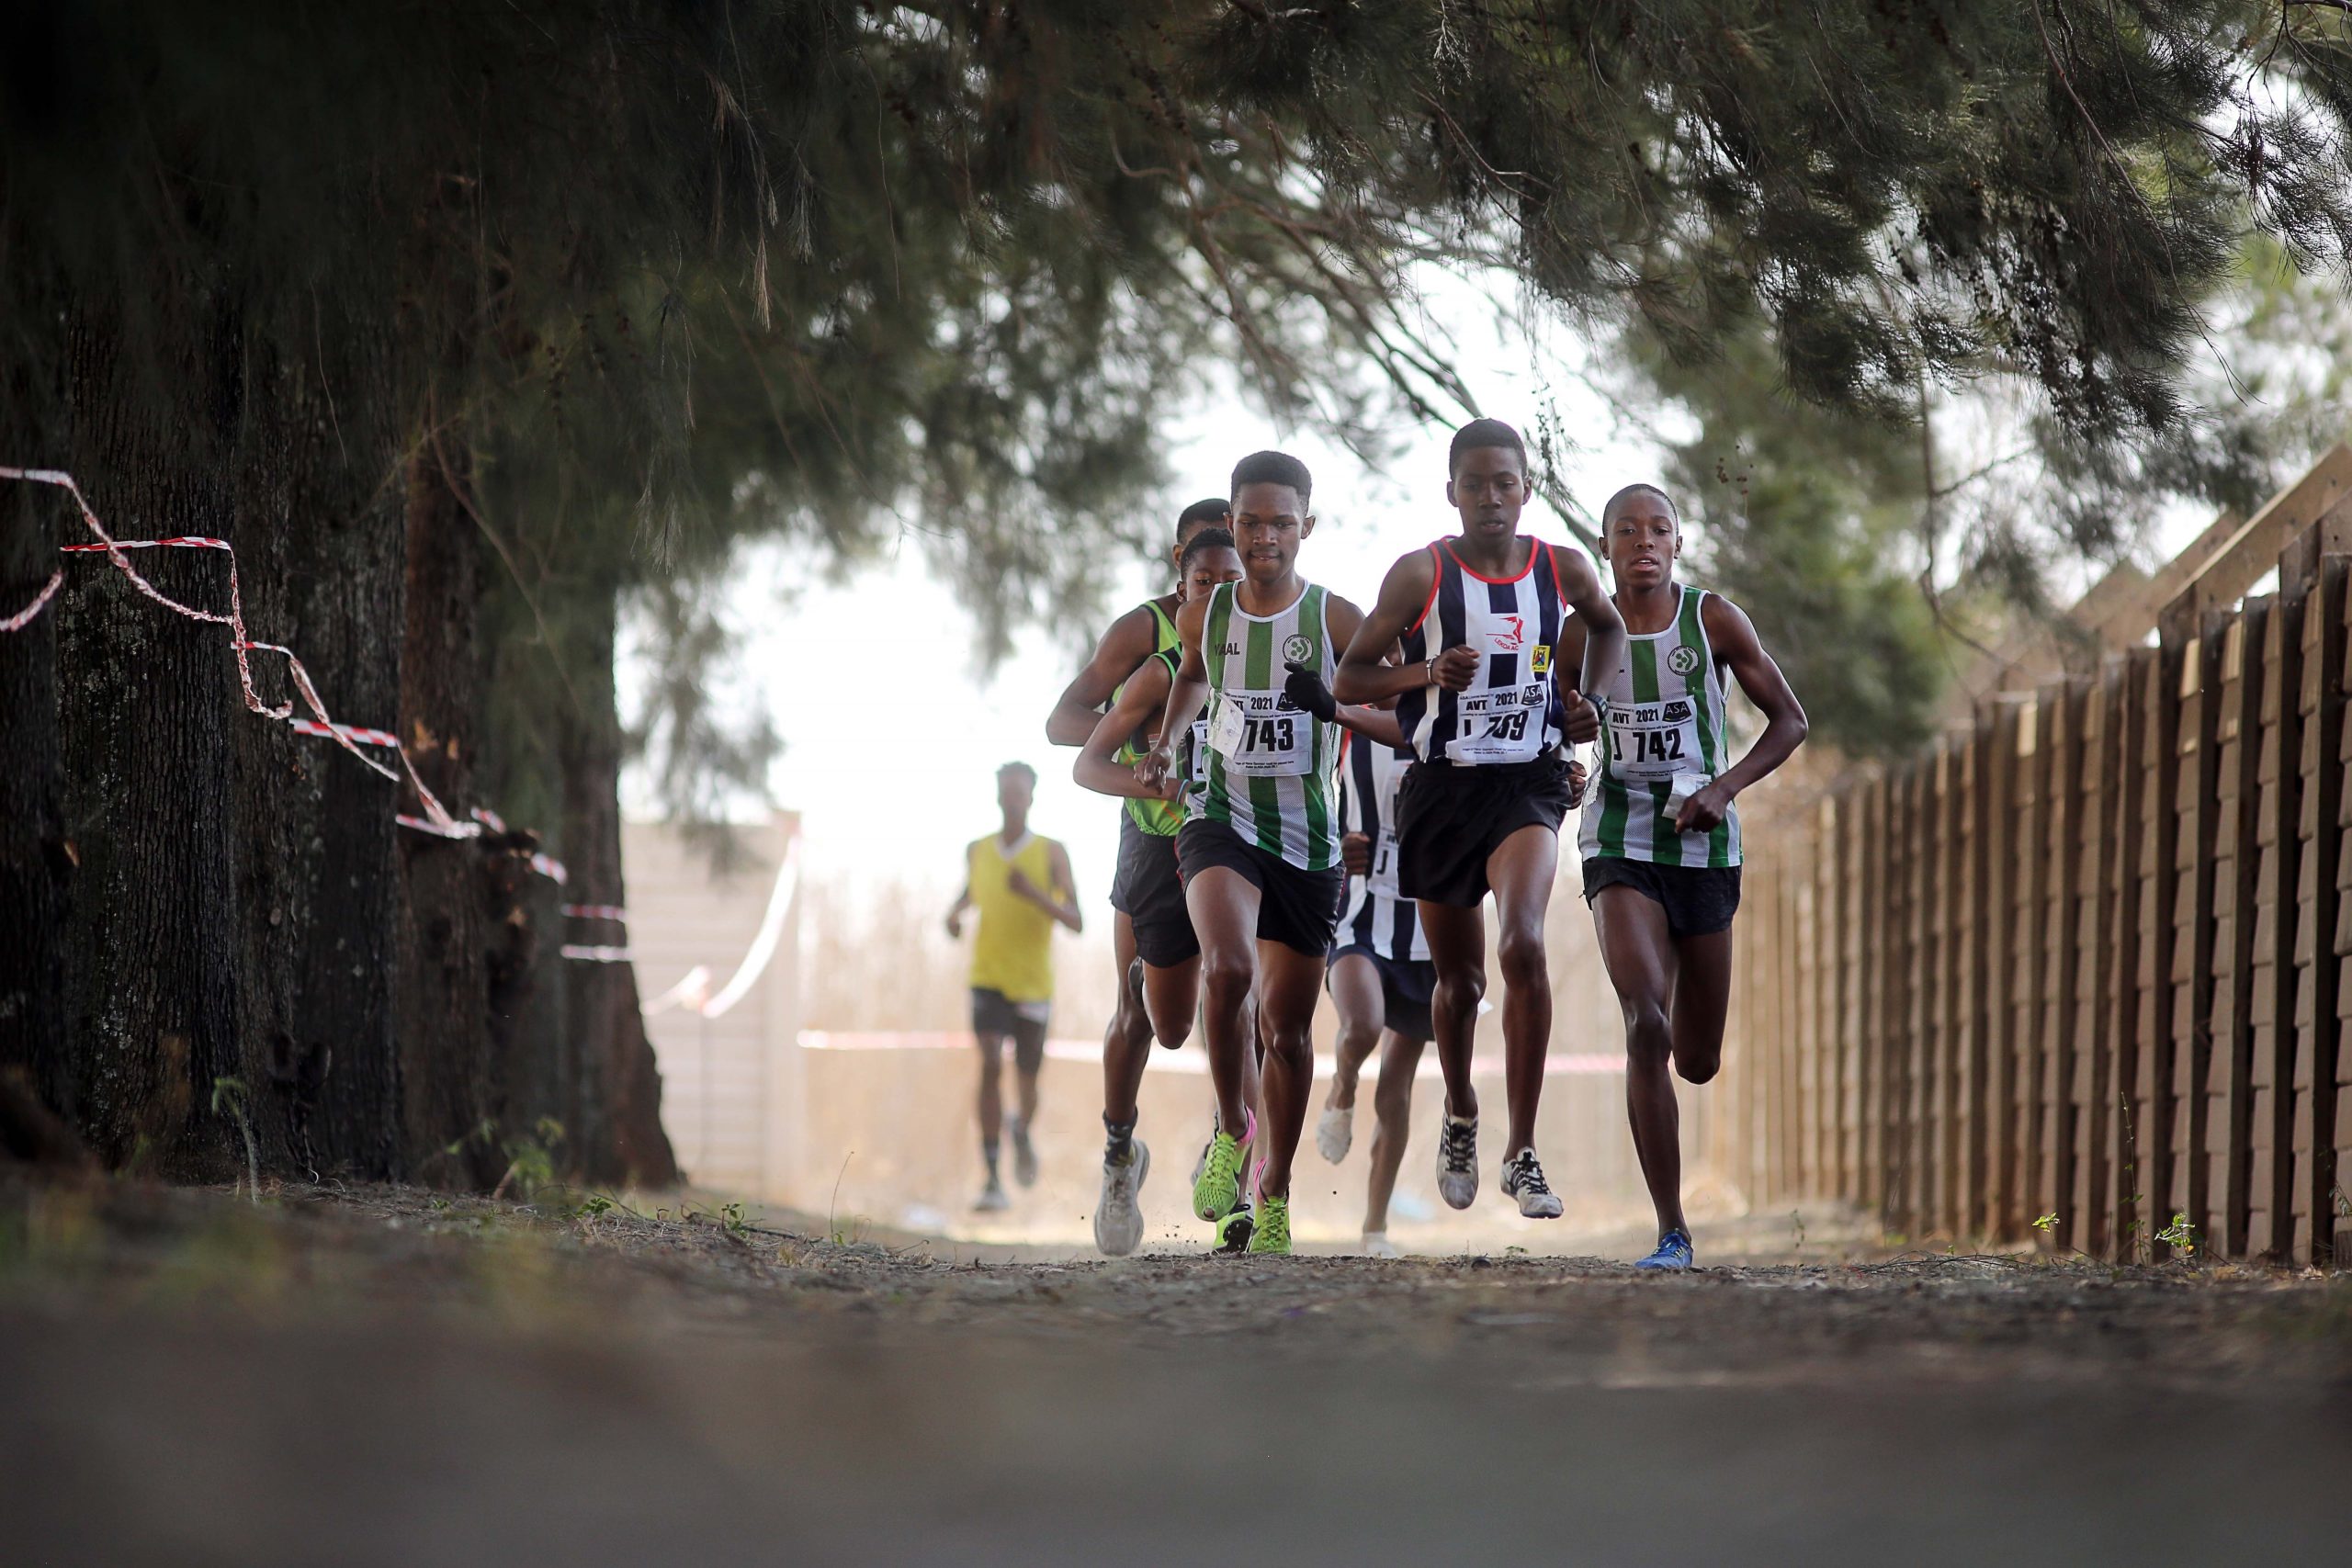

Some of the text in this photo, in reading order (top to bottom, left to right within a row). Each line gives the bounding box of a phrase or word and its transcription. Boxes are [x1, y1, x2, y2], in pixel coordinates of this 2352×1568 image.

[1525, 687, 1543, 697] ASA
[1250, 697, 1272, 709] 2021
[1466, 700, 1487, 711] AVT
[1496, 692, 1518, 705] 2021
[1612, 709, 1658, 724] AVT 2021
[1667, 705, 1688, 714] ASA
[1245, 718, 1294, 751] 743
[1613, 728, 1685, 762] J 742
